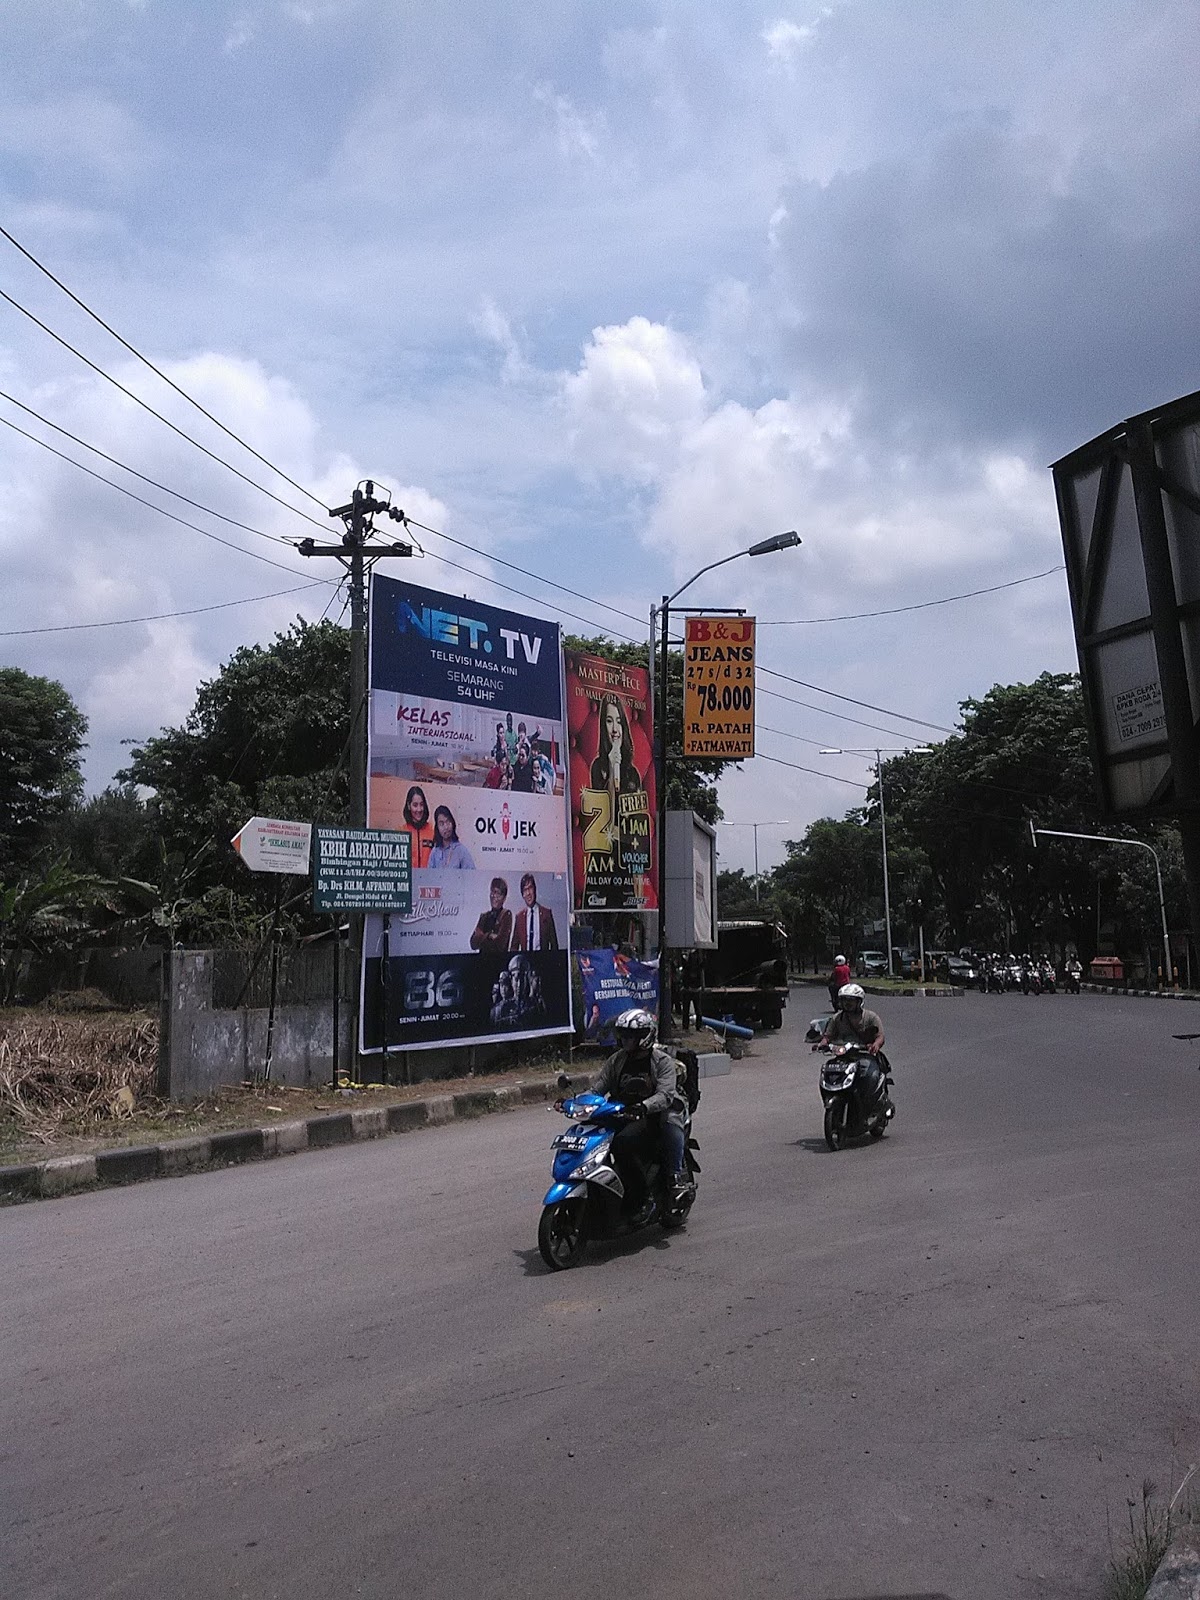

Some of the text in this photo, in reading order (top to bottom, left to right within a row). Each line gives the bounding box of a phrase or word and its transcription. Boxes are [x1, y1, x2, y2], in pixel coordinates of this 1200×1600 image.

[397, 601, 542, 665] NET. TV
[430, 649, 518, 676] TELEVISI MASA KINI
[688, 646, 753, 662] JEANS
[447, 670, 504, 691] SEMARANG
[578, 665, 641, 691] MASTERPIECE
[687, 664, 752, 681] 27 s/d 32
[457, 685, 496, 701] 54 UHF
[585, 689, 601, 701] MALL
[687, 681, 751, 717] Rp 78.000
[1117, 691, 1135, 703] DANA
[1136, 683, 1157, 695] CEPAT
[1134, 693, 1152, 705] RODA
[397, 705, 452, 727] KELAS
[407, 726, 475, 742] INTERNASIONAL
[691, 723, 752, 734] R. PATAH
[690, 740, 752, 752] FATMAWATI
[621, 794, 647, 813] FREE
[475, 817, 537, 840] OK JEK
[580, 789, 613, 854] 2
[621, 819, 648, 837] 1 JAM
[318, 828, 345, 839] YAYASAN
[320, 840, 408, 860] KBIH ARRAUDLAH
[622, 852, 649, 863] VOUCHER
[320, 857, 361, 868] Bimbingan
[362, 860, 378, 868] Haji
[583, 855, 615, 875] JAM
[632, 864, 644, 874] JAM
[330, 880, 343, 890] Drs
[396, 882, 409, 892] MM
[586, 876, 598, 886] ALL
[598, 876, 612, 886] DAY
[623, 877, 634, 886] ALL
